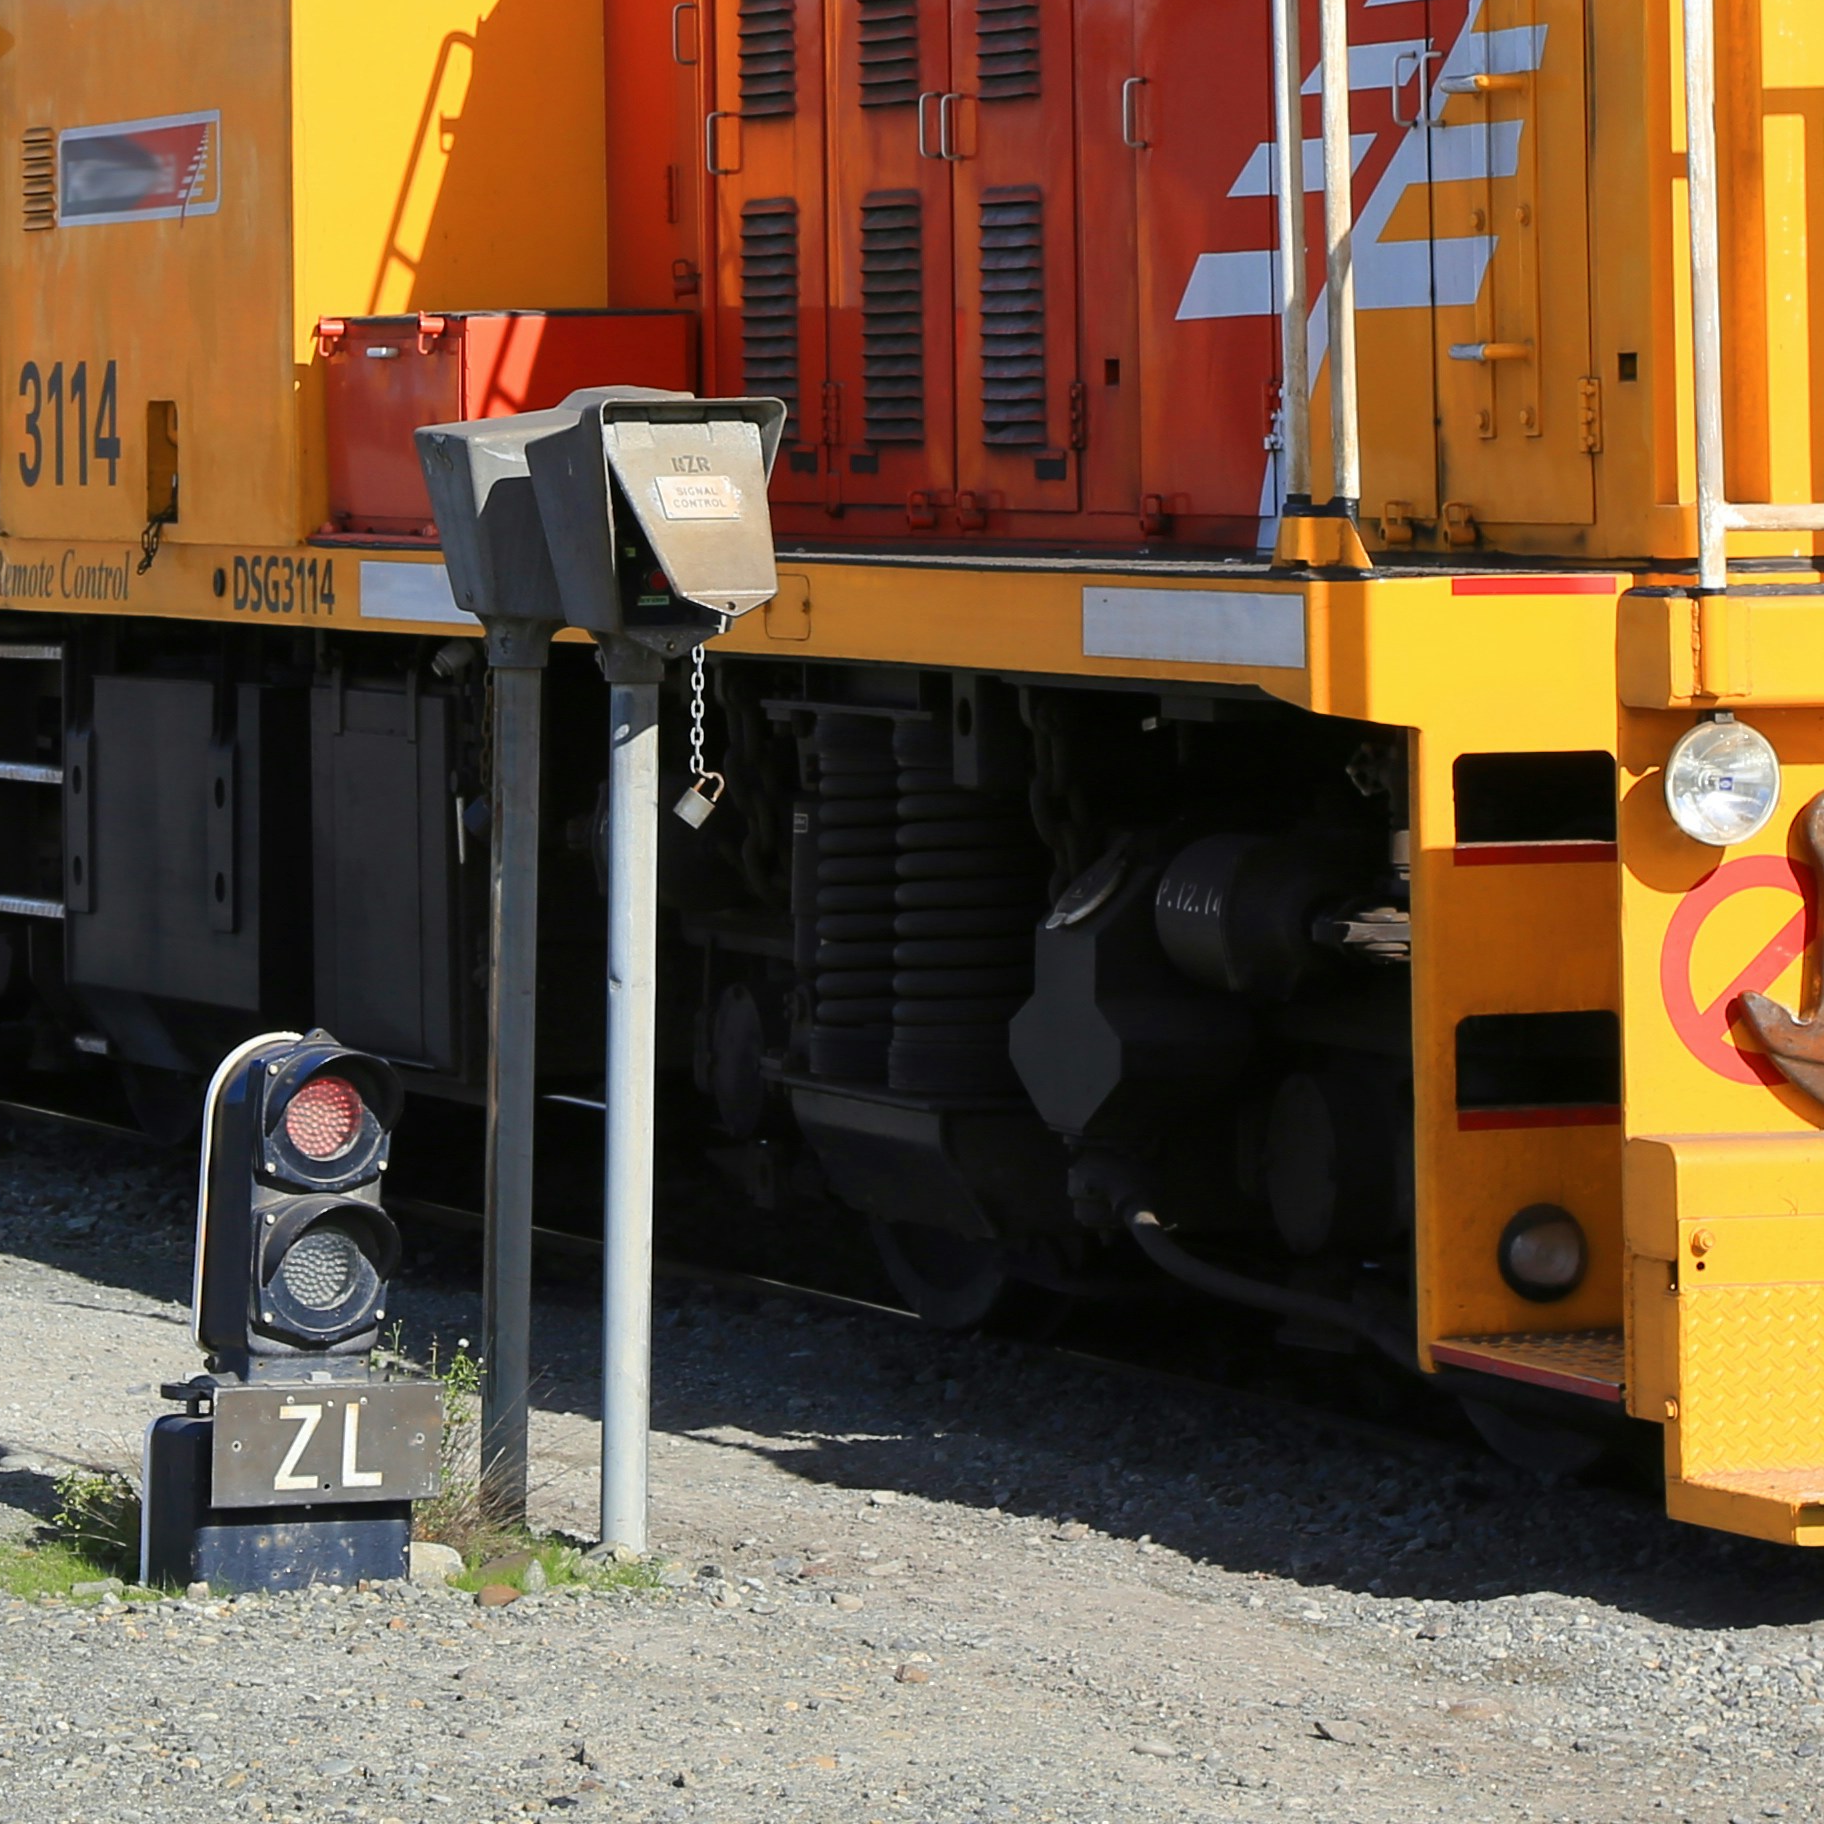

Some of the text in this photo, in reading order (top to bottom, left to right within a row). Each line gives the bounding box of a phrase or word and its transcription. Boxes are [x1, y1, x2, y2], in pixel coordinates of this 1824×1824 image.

[19, 359, 121, 487] 3114
[673, 498, 728, 508] CONTROL
[676, 486, 719, 496] SIGNAL
[60, 549, 130, 601] Control
[233, 555, 335, 616] DSG3114
